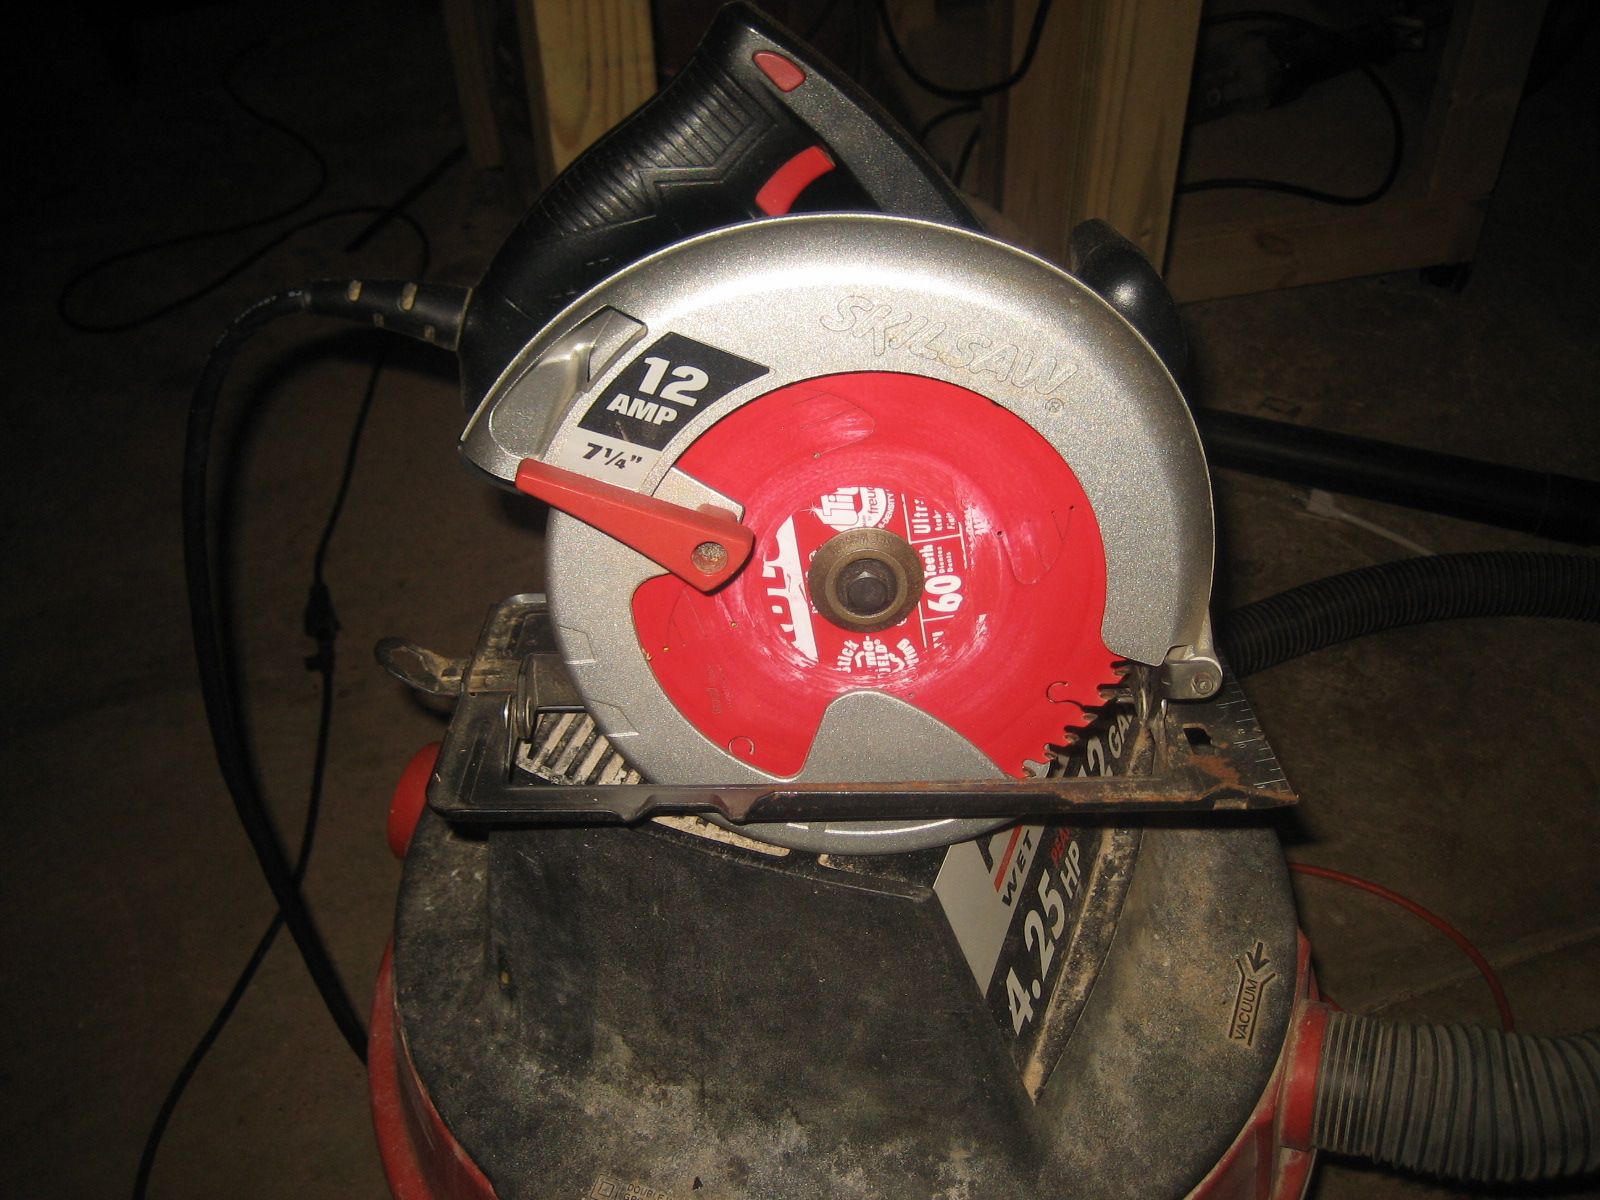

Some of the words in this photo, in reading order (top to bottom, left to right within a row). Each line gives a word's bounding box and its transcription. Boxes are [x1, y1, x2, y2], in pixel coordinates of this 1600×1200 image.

[638, 356, 709, 407] 12
[606, 393, 679, 426] AMP
[919, 544, 937, 579] Teeth
[924, 575, 964, 613] 60
[1001, 828, 1034, 907] WET
[1005, 868, 1066, 1037] 4.25
[1059, 839, 1083, 900] HP
[1234, 978, 1259, 1040] VACUUM
